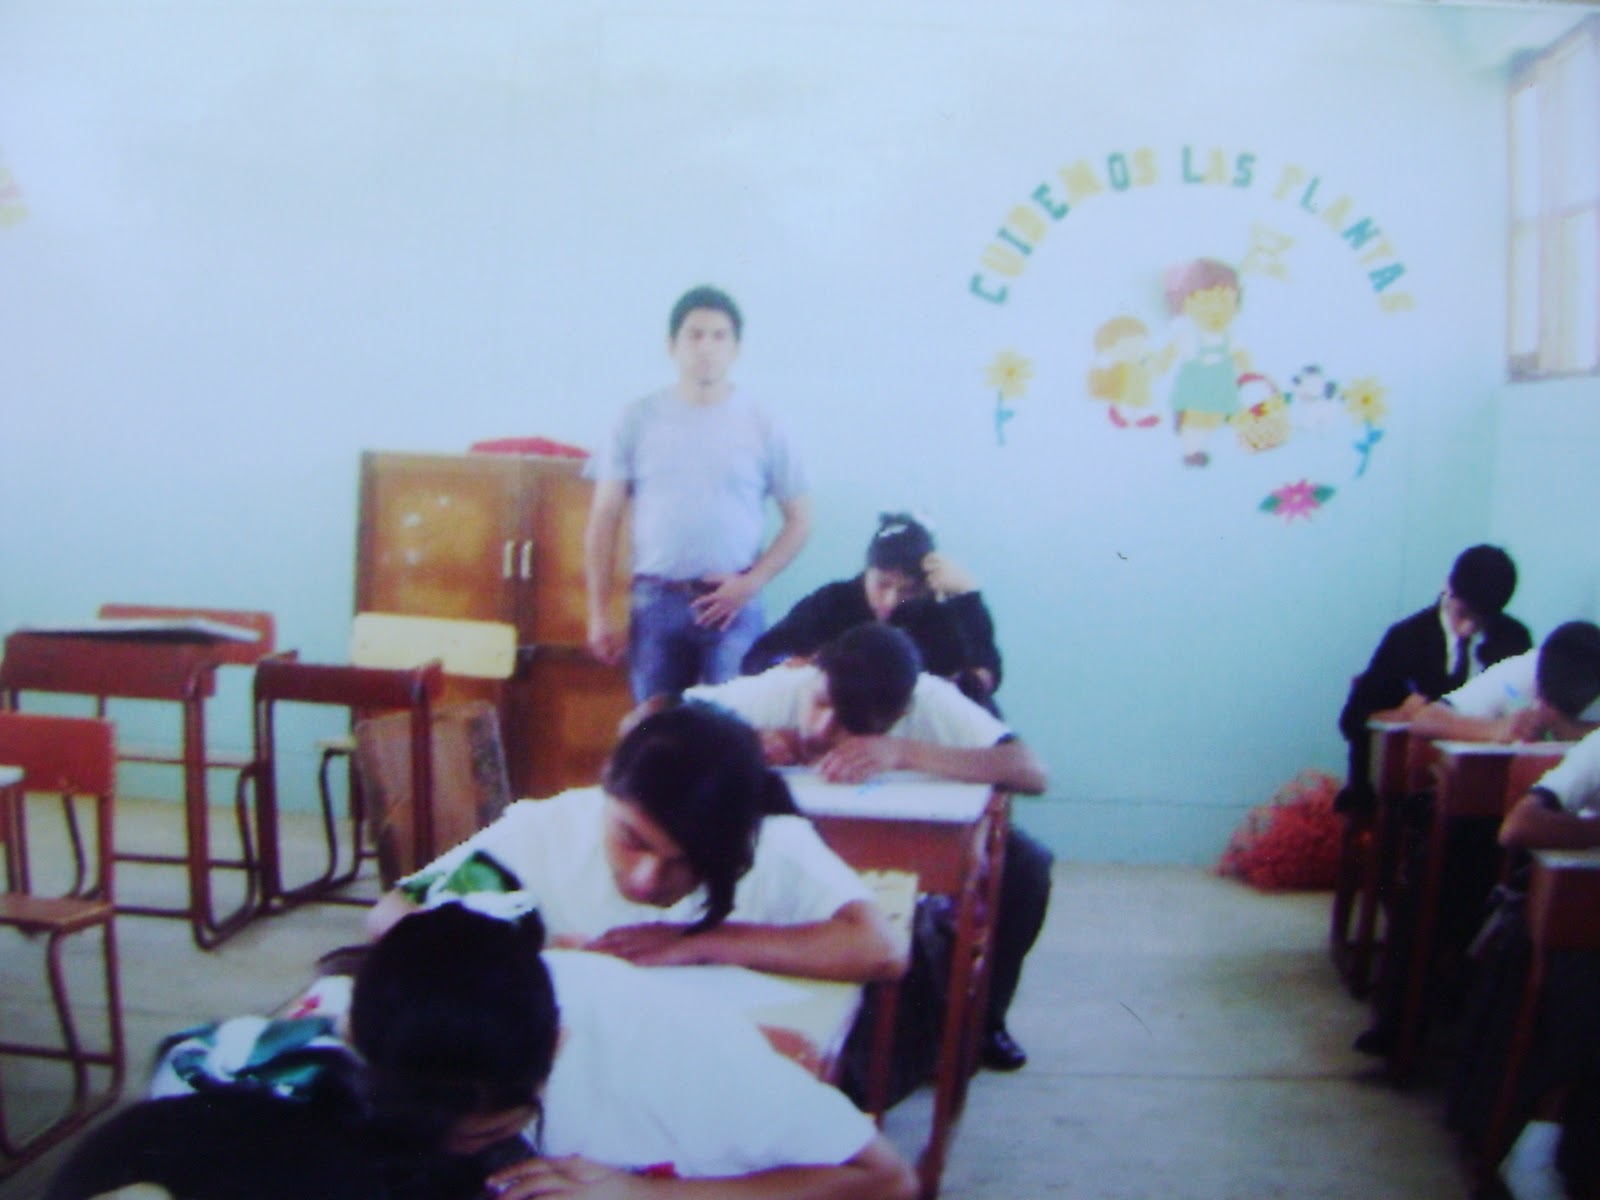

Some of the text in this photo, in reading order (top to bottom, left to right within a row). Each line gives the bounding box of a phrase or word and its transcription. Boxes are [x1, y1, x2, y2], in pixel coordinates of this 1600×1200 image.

[969, 145, 1417, 314] CUIDEMOS LAS PLANTAS
